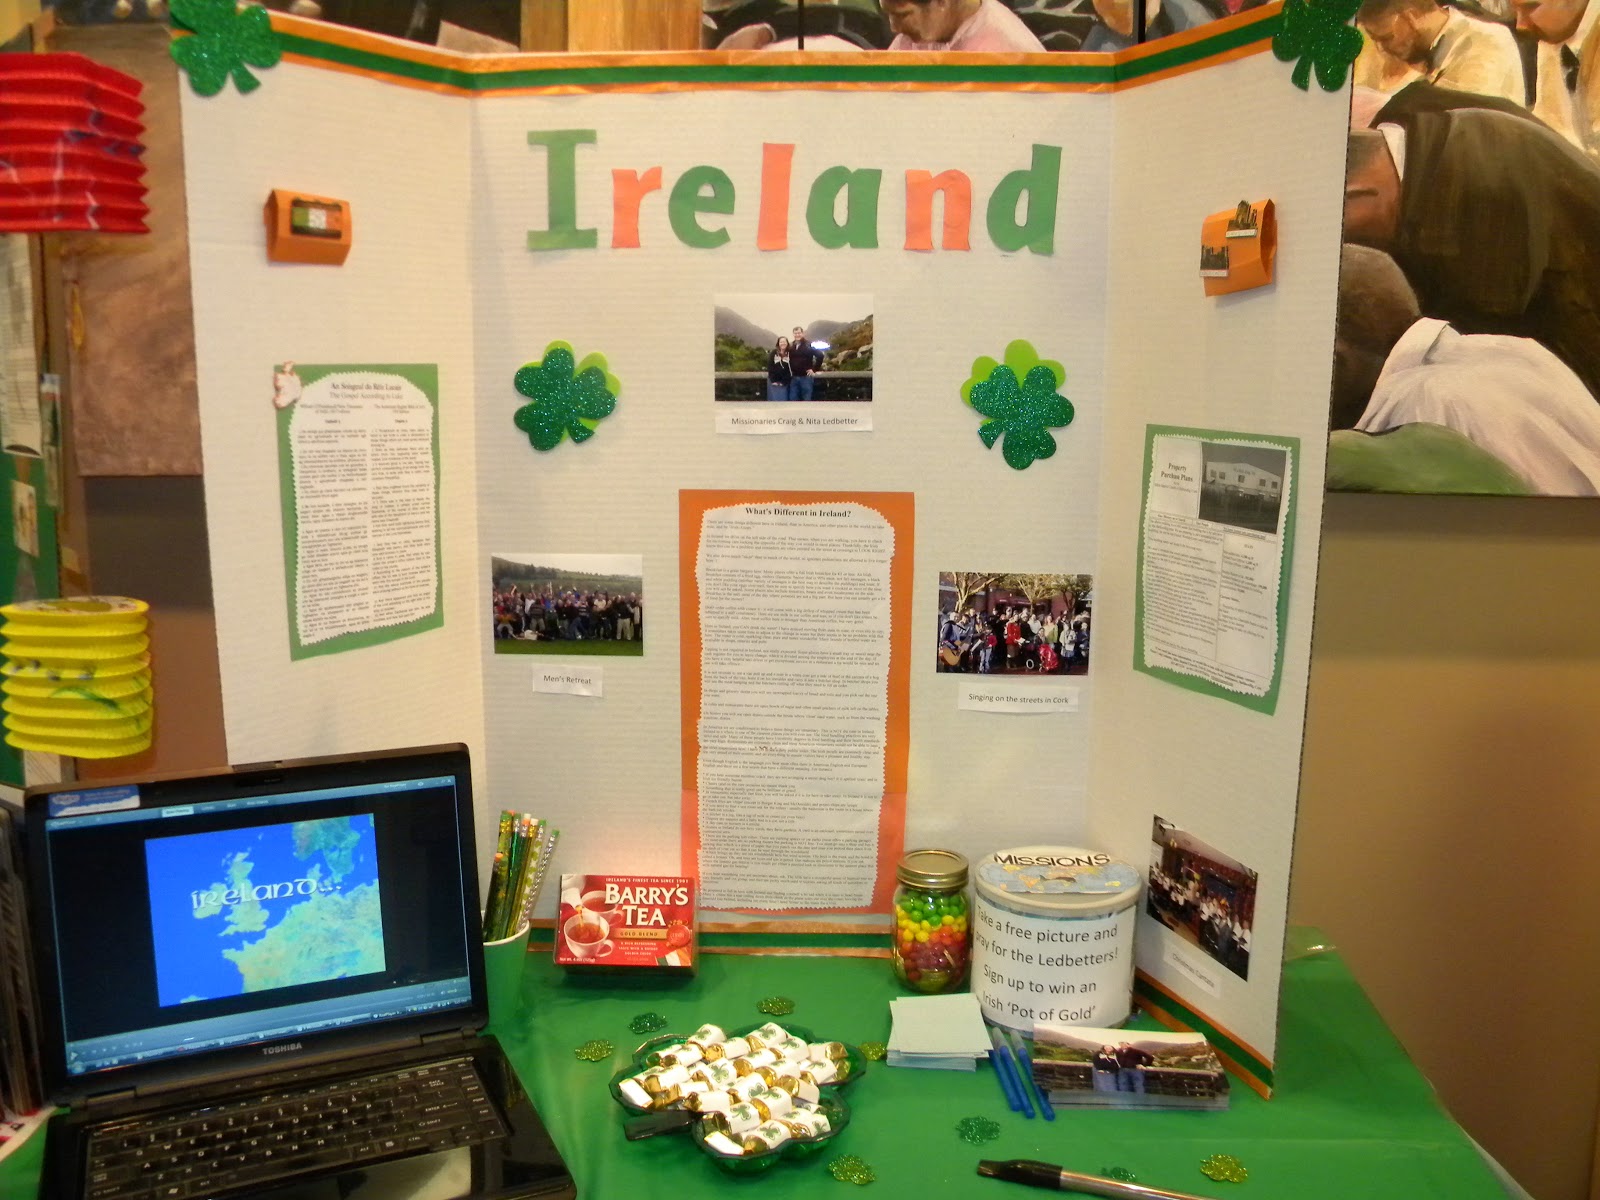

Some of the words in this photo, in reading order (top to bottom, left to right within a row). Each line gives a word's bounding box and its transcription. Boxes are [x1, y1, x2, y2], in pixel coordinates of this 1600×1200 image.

[527, 129, 1062, 255] Ireland
[778, 418, 796, 426] Craig
[1168, 463, 1186, 472] Property
[1181, 474, 1193, 482] Plans
[774, 508, 808, 516] Different
[819, 509, 851, 517] Ireland?
[968, 693, 994, 702] Singing
[994, 853, 1111, 866] MISSIONS
[604, 883, 688, 905] BARRY'S
[621, 905, 666, 926] TEA
[977, 906, 994, 928] Take
[996, 922, 1002, 932] a
[1006, 921, 1032, 940] free
[1037, 929, 1089, 944] picture
[1094, 924, 1118, 941] and
[992, 940, 1007, 957] for
[1011, 949, 1034, 963] the
[1038, 947, 1118, 967] Ledbetters!
[983, 964, 1004, 984] Sign
[1007, 978, 1025, 992] up
[1029, 980, 1044, 993] to
[1048, 981, 1075, 994] win
[1080, 982, 1096, 993] an
[982, 990, 1003, 1011] Irish
[1040, 1009, 1055, 1021] of
[262, 1042, 302, 1056] TOSHIBA
